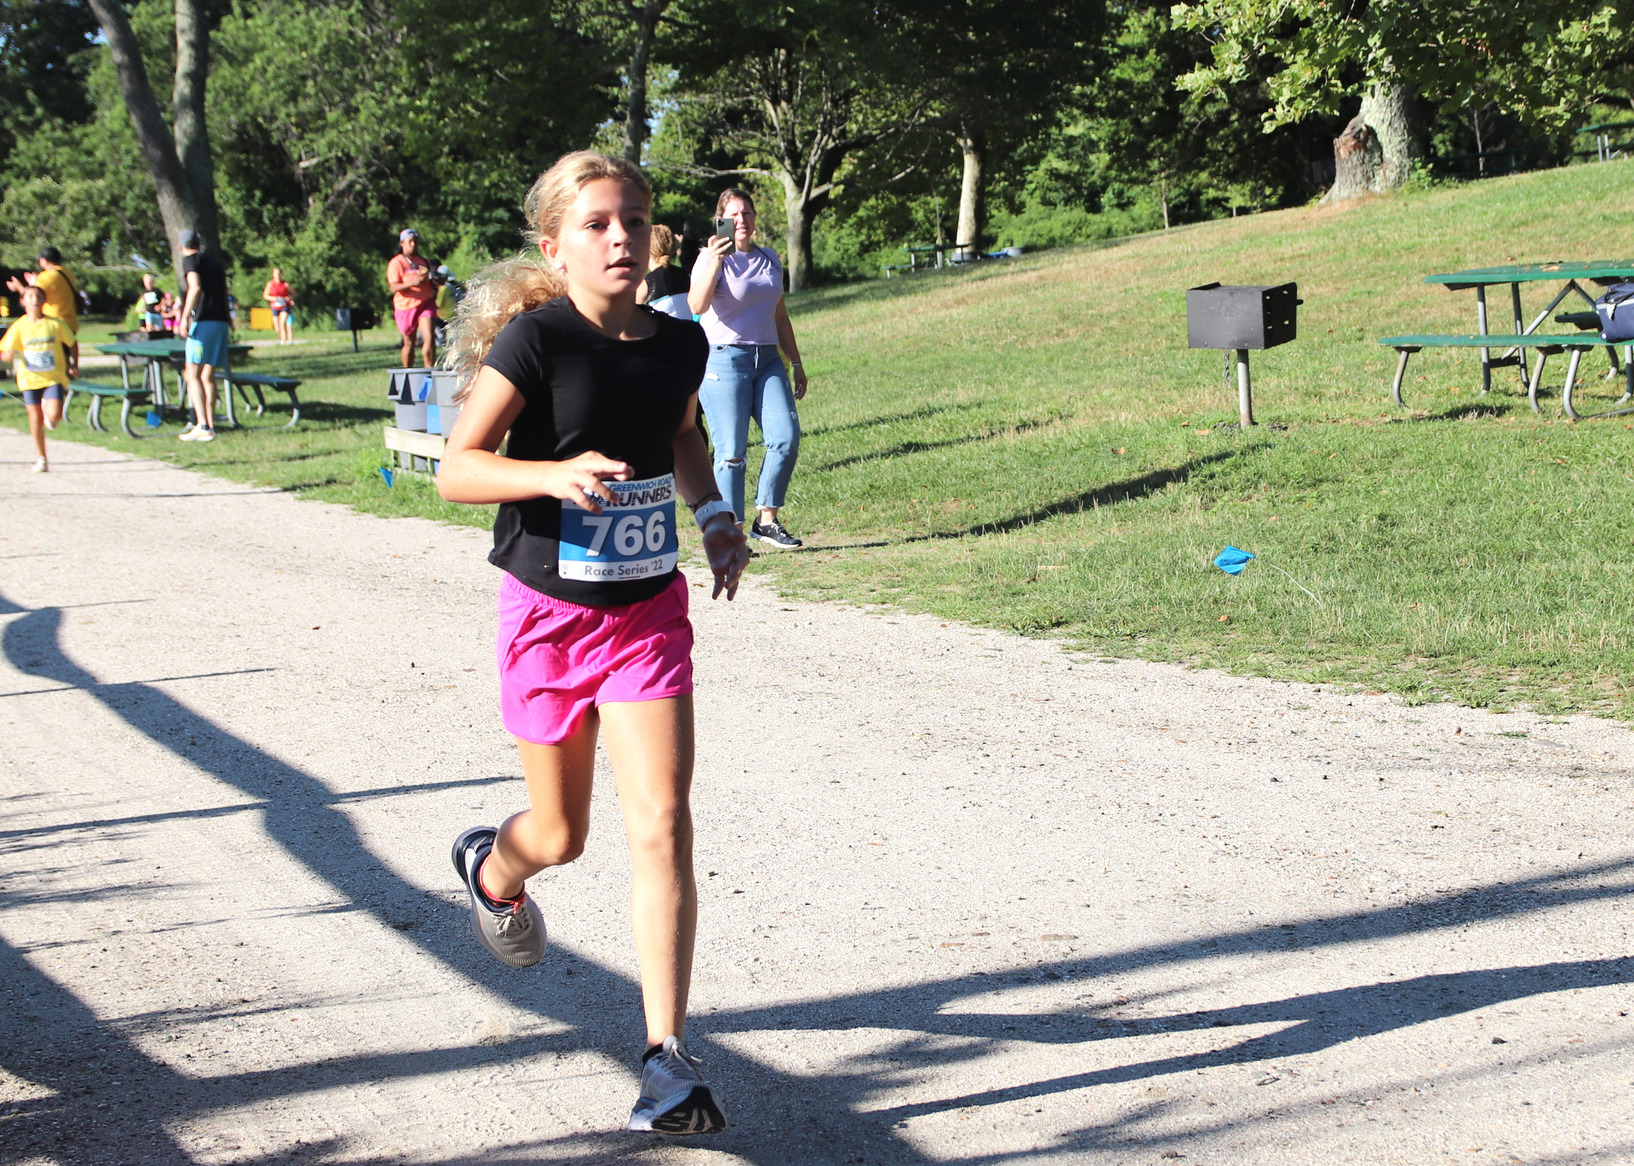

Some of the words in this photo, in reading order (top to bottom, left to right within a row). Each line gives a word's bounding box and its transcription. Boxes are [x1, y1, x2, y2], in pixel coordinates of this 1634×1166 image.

[609, 480, 657, 492] GREENWICH
[657, 477, 672, 487] ROAD
[582, 511, 665, 556] 766
[585, 565, 614, 576] Race
[617, 564, 649, 576] Series
[651, 559, 663, 571] '22
